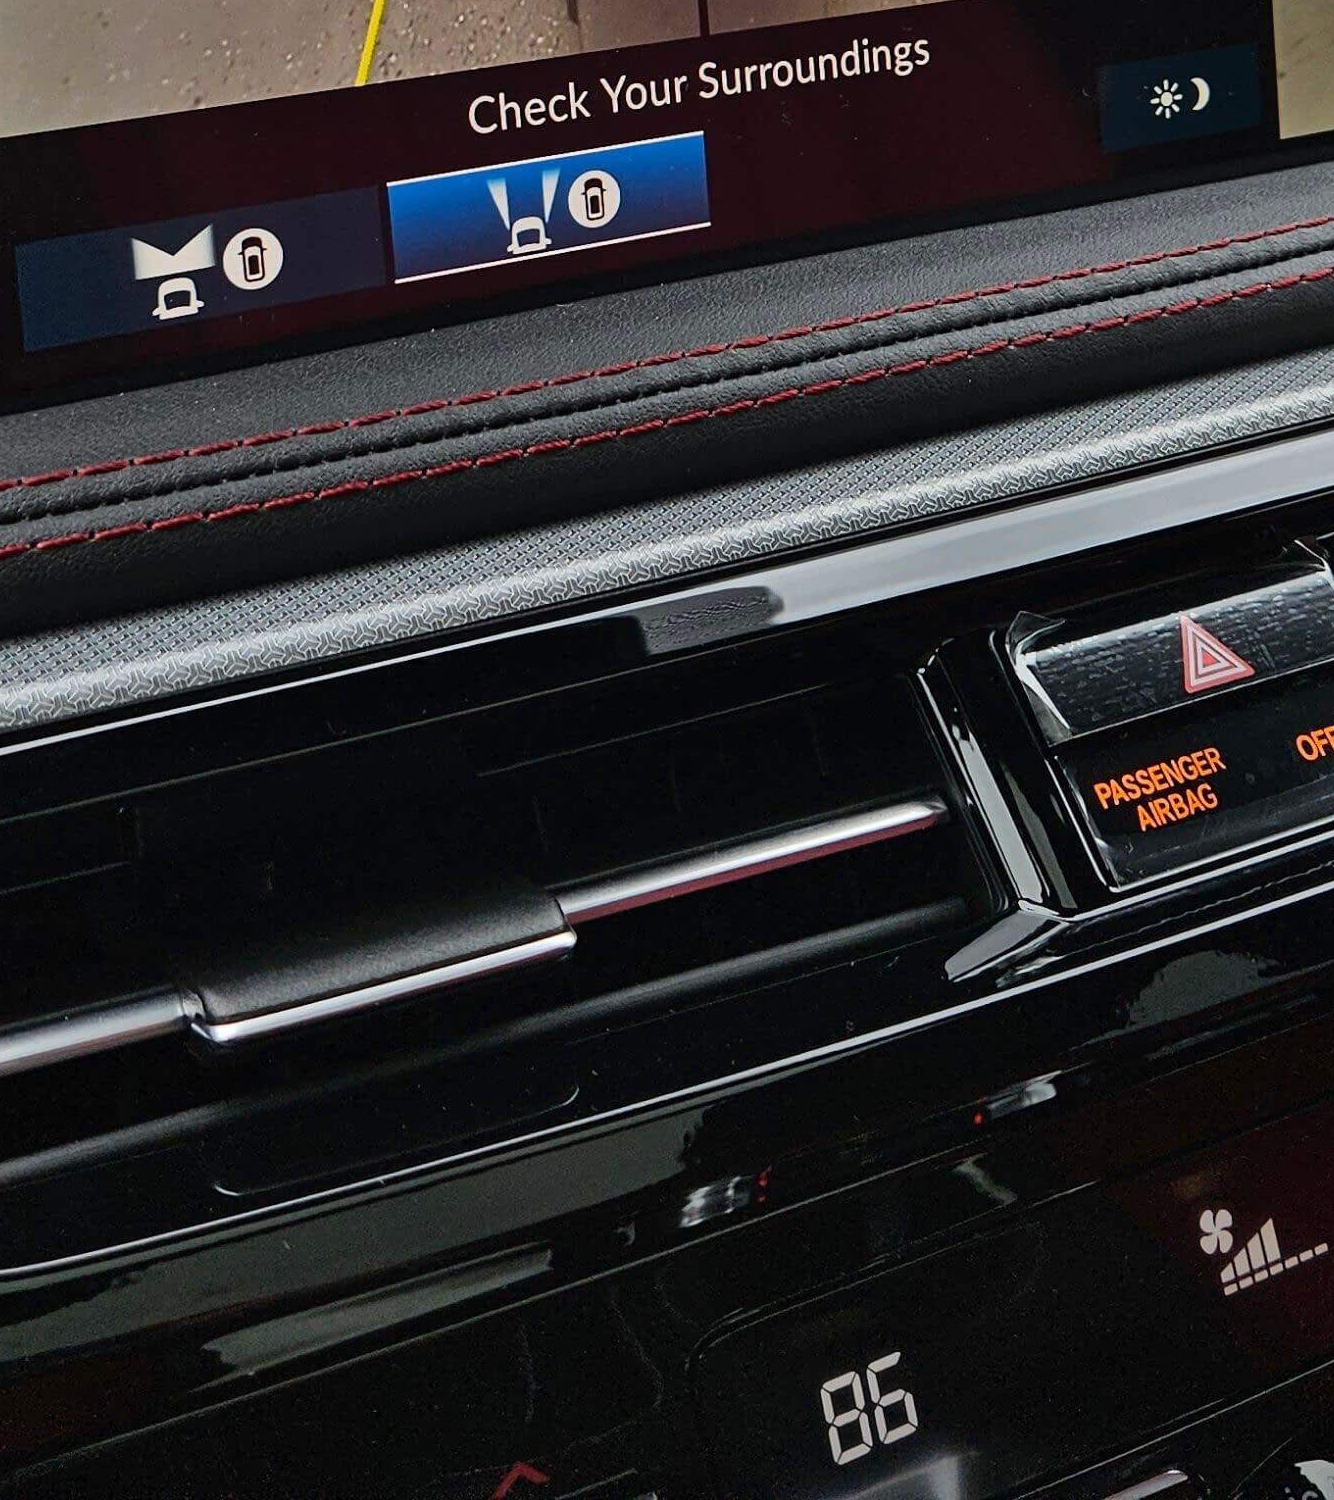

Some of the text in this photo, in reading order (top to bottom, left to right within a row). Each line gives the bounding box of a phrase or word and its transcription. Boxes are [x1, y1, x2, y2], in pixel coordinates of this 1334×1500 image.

[467, 37, 931, 134] Check Your Surroundings
[1093, 746, 1227, 810] PASSENGER
[1136, 782, 1218, 833] AIRBAG
[820, 1351, 919, 1466] 86
